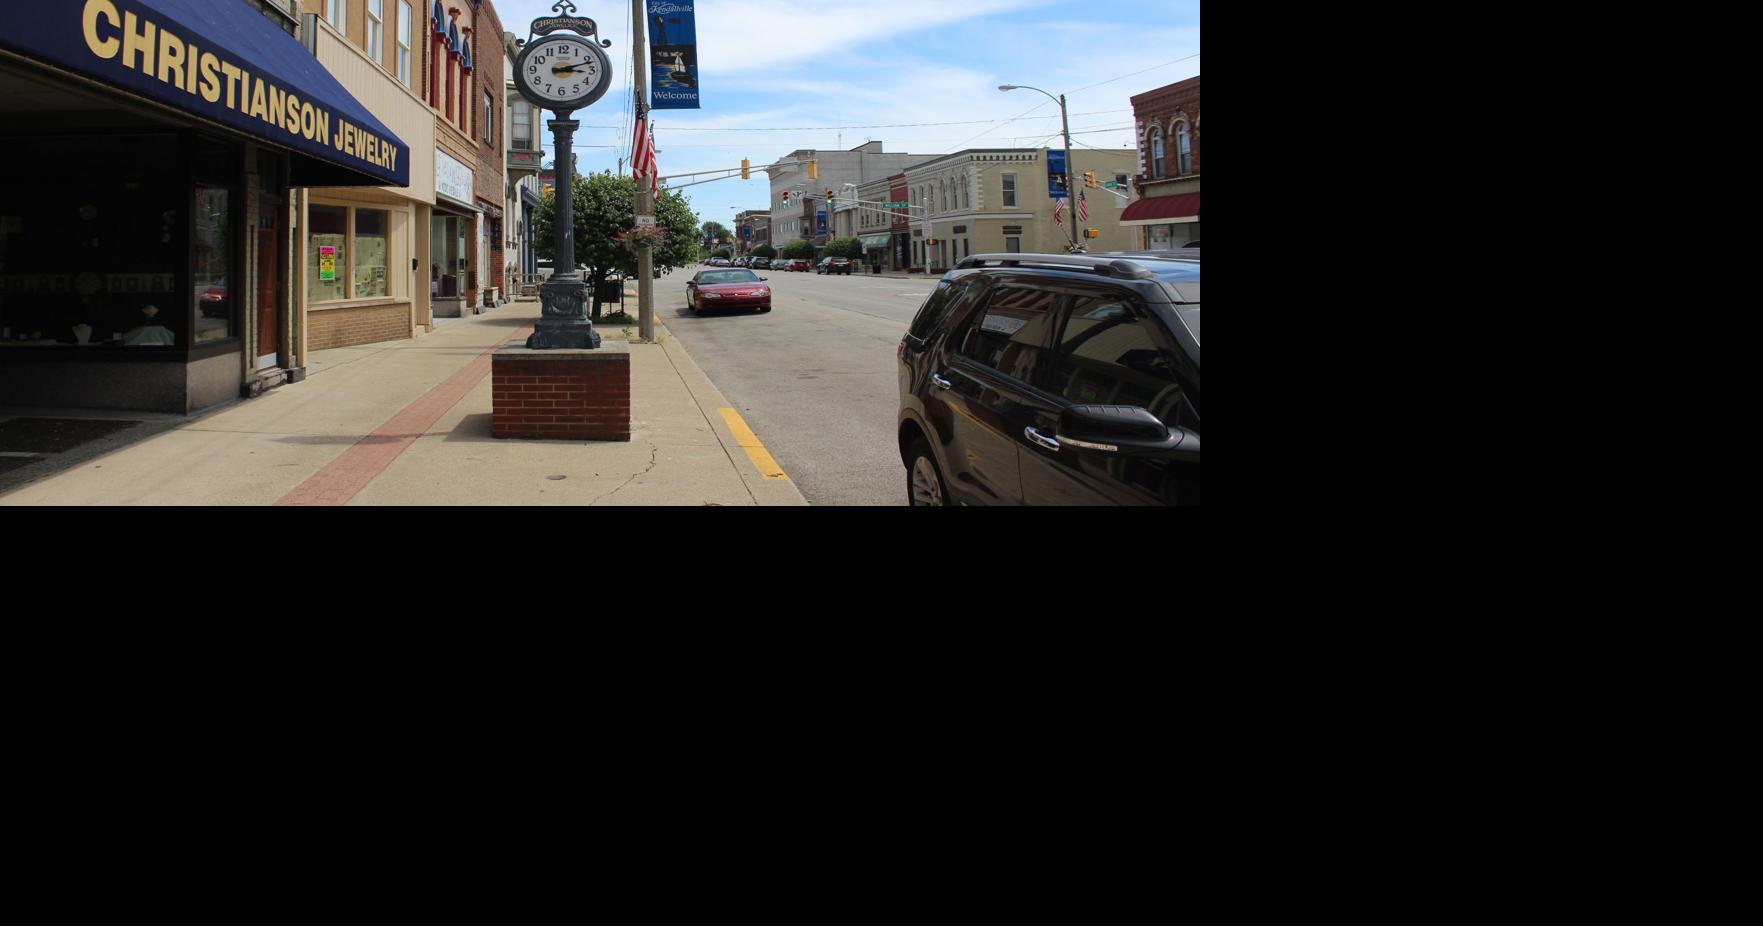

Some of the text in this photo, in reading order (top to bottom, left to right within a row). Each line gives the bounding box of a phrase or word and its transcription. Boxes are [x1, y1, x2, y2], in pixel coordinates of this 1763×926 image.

[533, 18, 593, 29] CHRISTIANSON
[545, 48, 554, 56] 11
[558, 45, 569, 54] 12
[574, 48, 578, 56] 1
[534, 56, 546, 64] 10
[584, 56, 591, 64] 2
[530, 66, 537, 74] 9
[588, 66, 596, 75] 3
[534, 76, 542, 85] 8
[582, 77, 589, 85] 4
[82, 0, 397, 171] CHRISTIANSON JEWELRY
[546, 84, 552, 93] 7
[572, 84, 580, 93] 5
[558, 87, 566, 96] 6
[653, 91, 698, 100] Welcome
